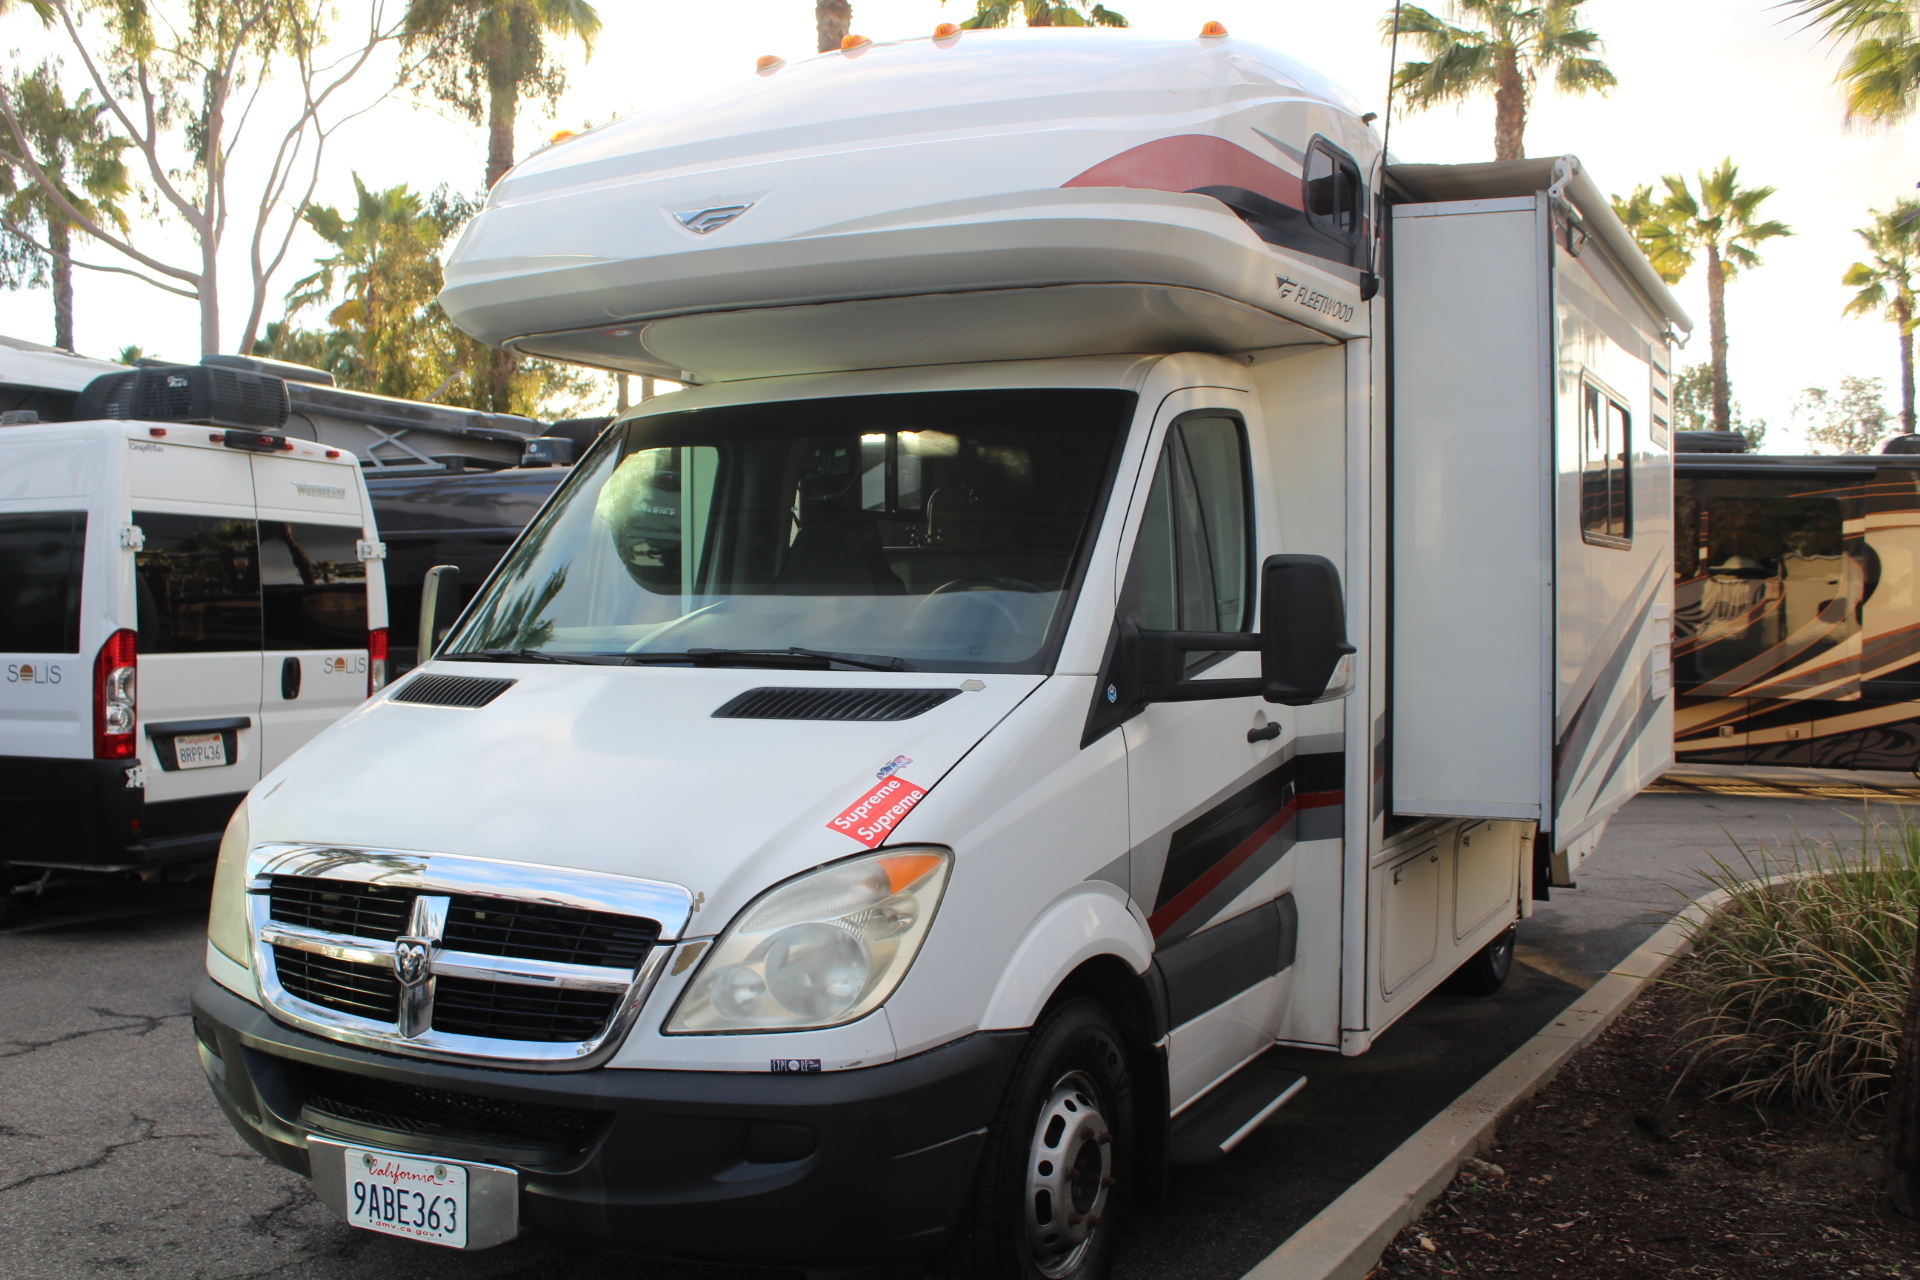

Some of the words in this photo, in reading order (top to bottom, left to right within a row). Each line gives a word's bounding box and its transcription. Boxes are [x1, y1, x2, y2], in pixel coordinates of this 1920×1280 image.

[1294, 286, 1354, 323] FLEETWOOD
[7, 662, 62, 684] SOLIS
[323, 656, 367, 674] SOLIS
[180, 745, 221, 762] 8RPP436
[834, 780, 901, 830] Supreme
[857, 789, 923, 841] Supreme
[368, 1158, 444, 1185] California
[354, 1181, 457, 1234] 9ABE363
[375, 1220, 436, 1237] dmv.ca.gov
